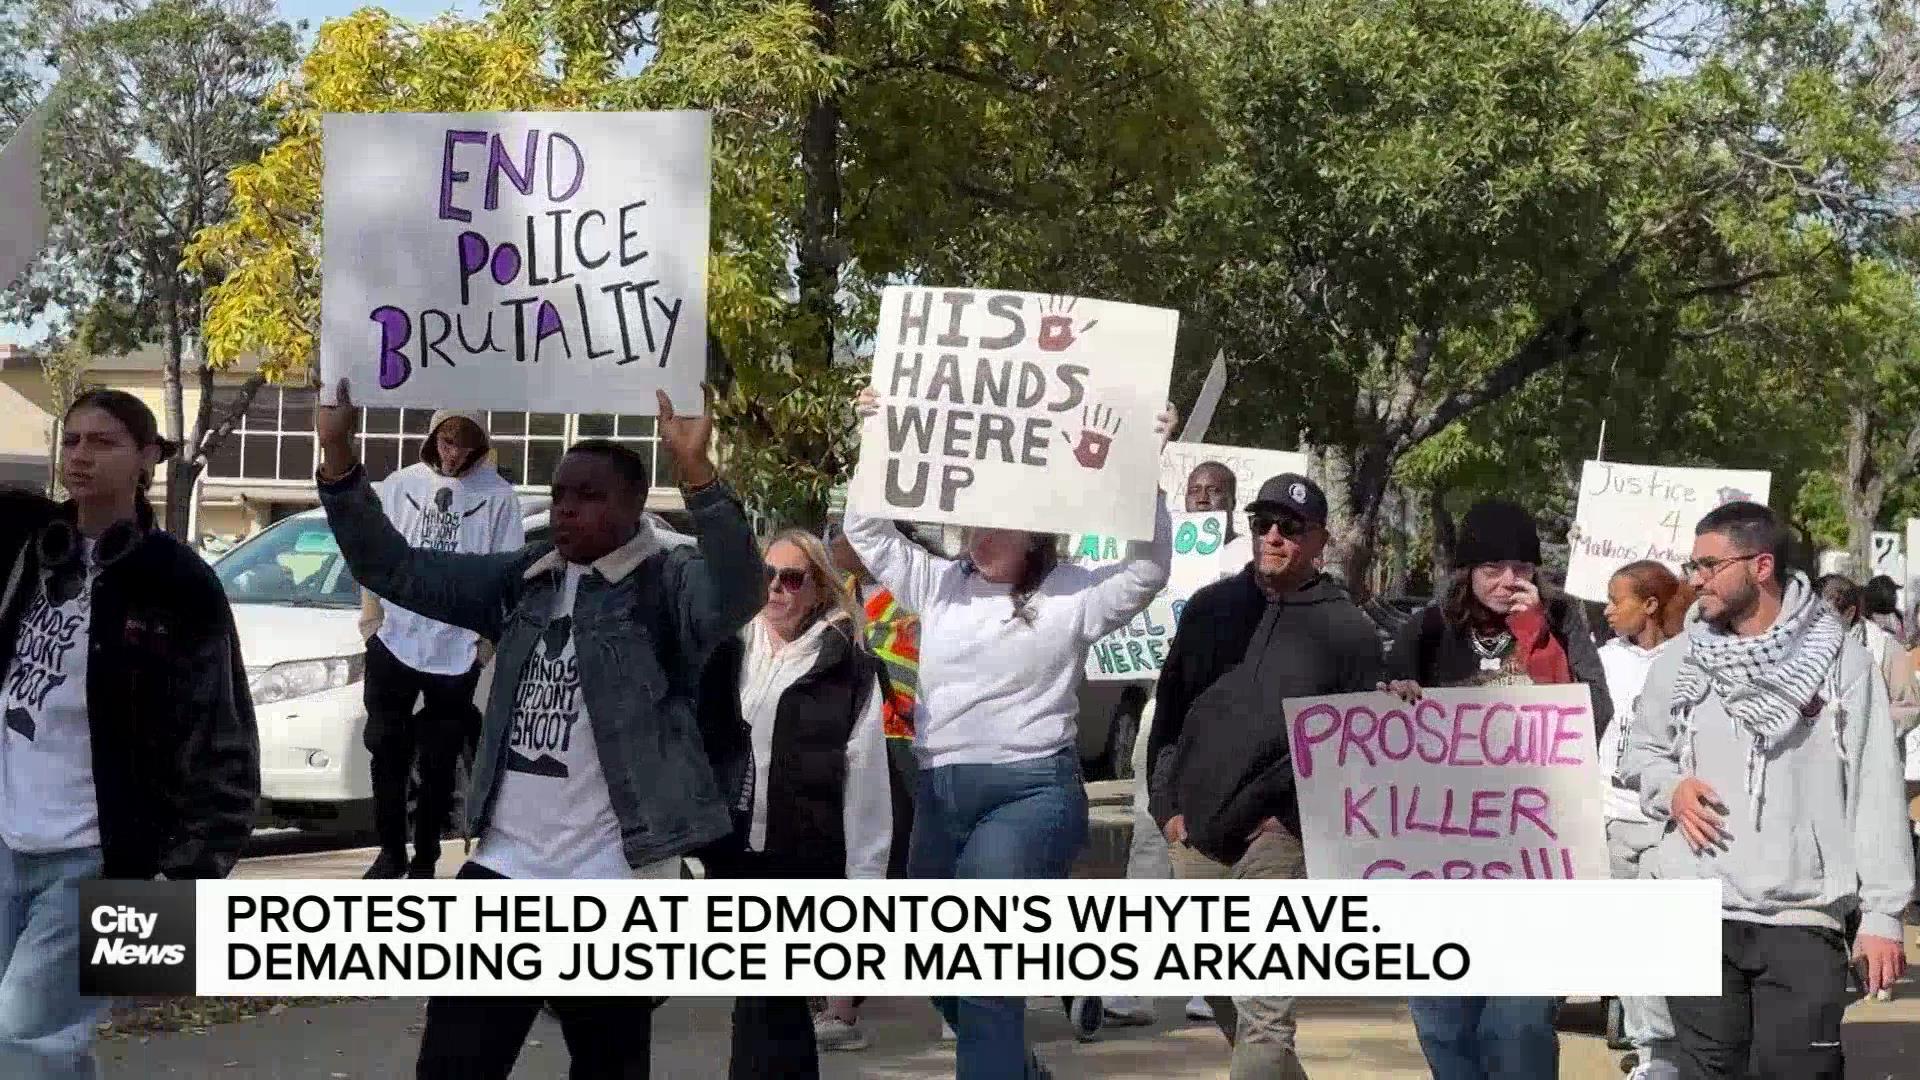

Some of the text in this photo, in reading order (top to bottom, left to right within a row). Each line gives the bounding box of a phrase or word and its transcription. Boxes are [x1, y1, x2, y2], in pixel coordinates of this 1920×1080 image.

[439, 129, 585, 223] END
[458, 200, 649, 305] POLICE
[370, 279, 683, 390] BRUTALITY
[897, 291, 1027, 351] HIS
[889, 351, 1091, 412] HANDS
[886, 404, 1053, 467] WERE
[884, 457, 975, 512] UP
[1589, 463, 1697, 502] Justice
[1657, 509, 1682, 543] 4
[510, 711, 579, 752] SHOOT
[1293, 700, 1588, 778] PROSECUTE
[1344, 785, 1559, 840] KILLER
